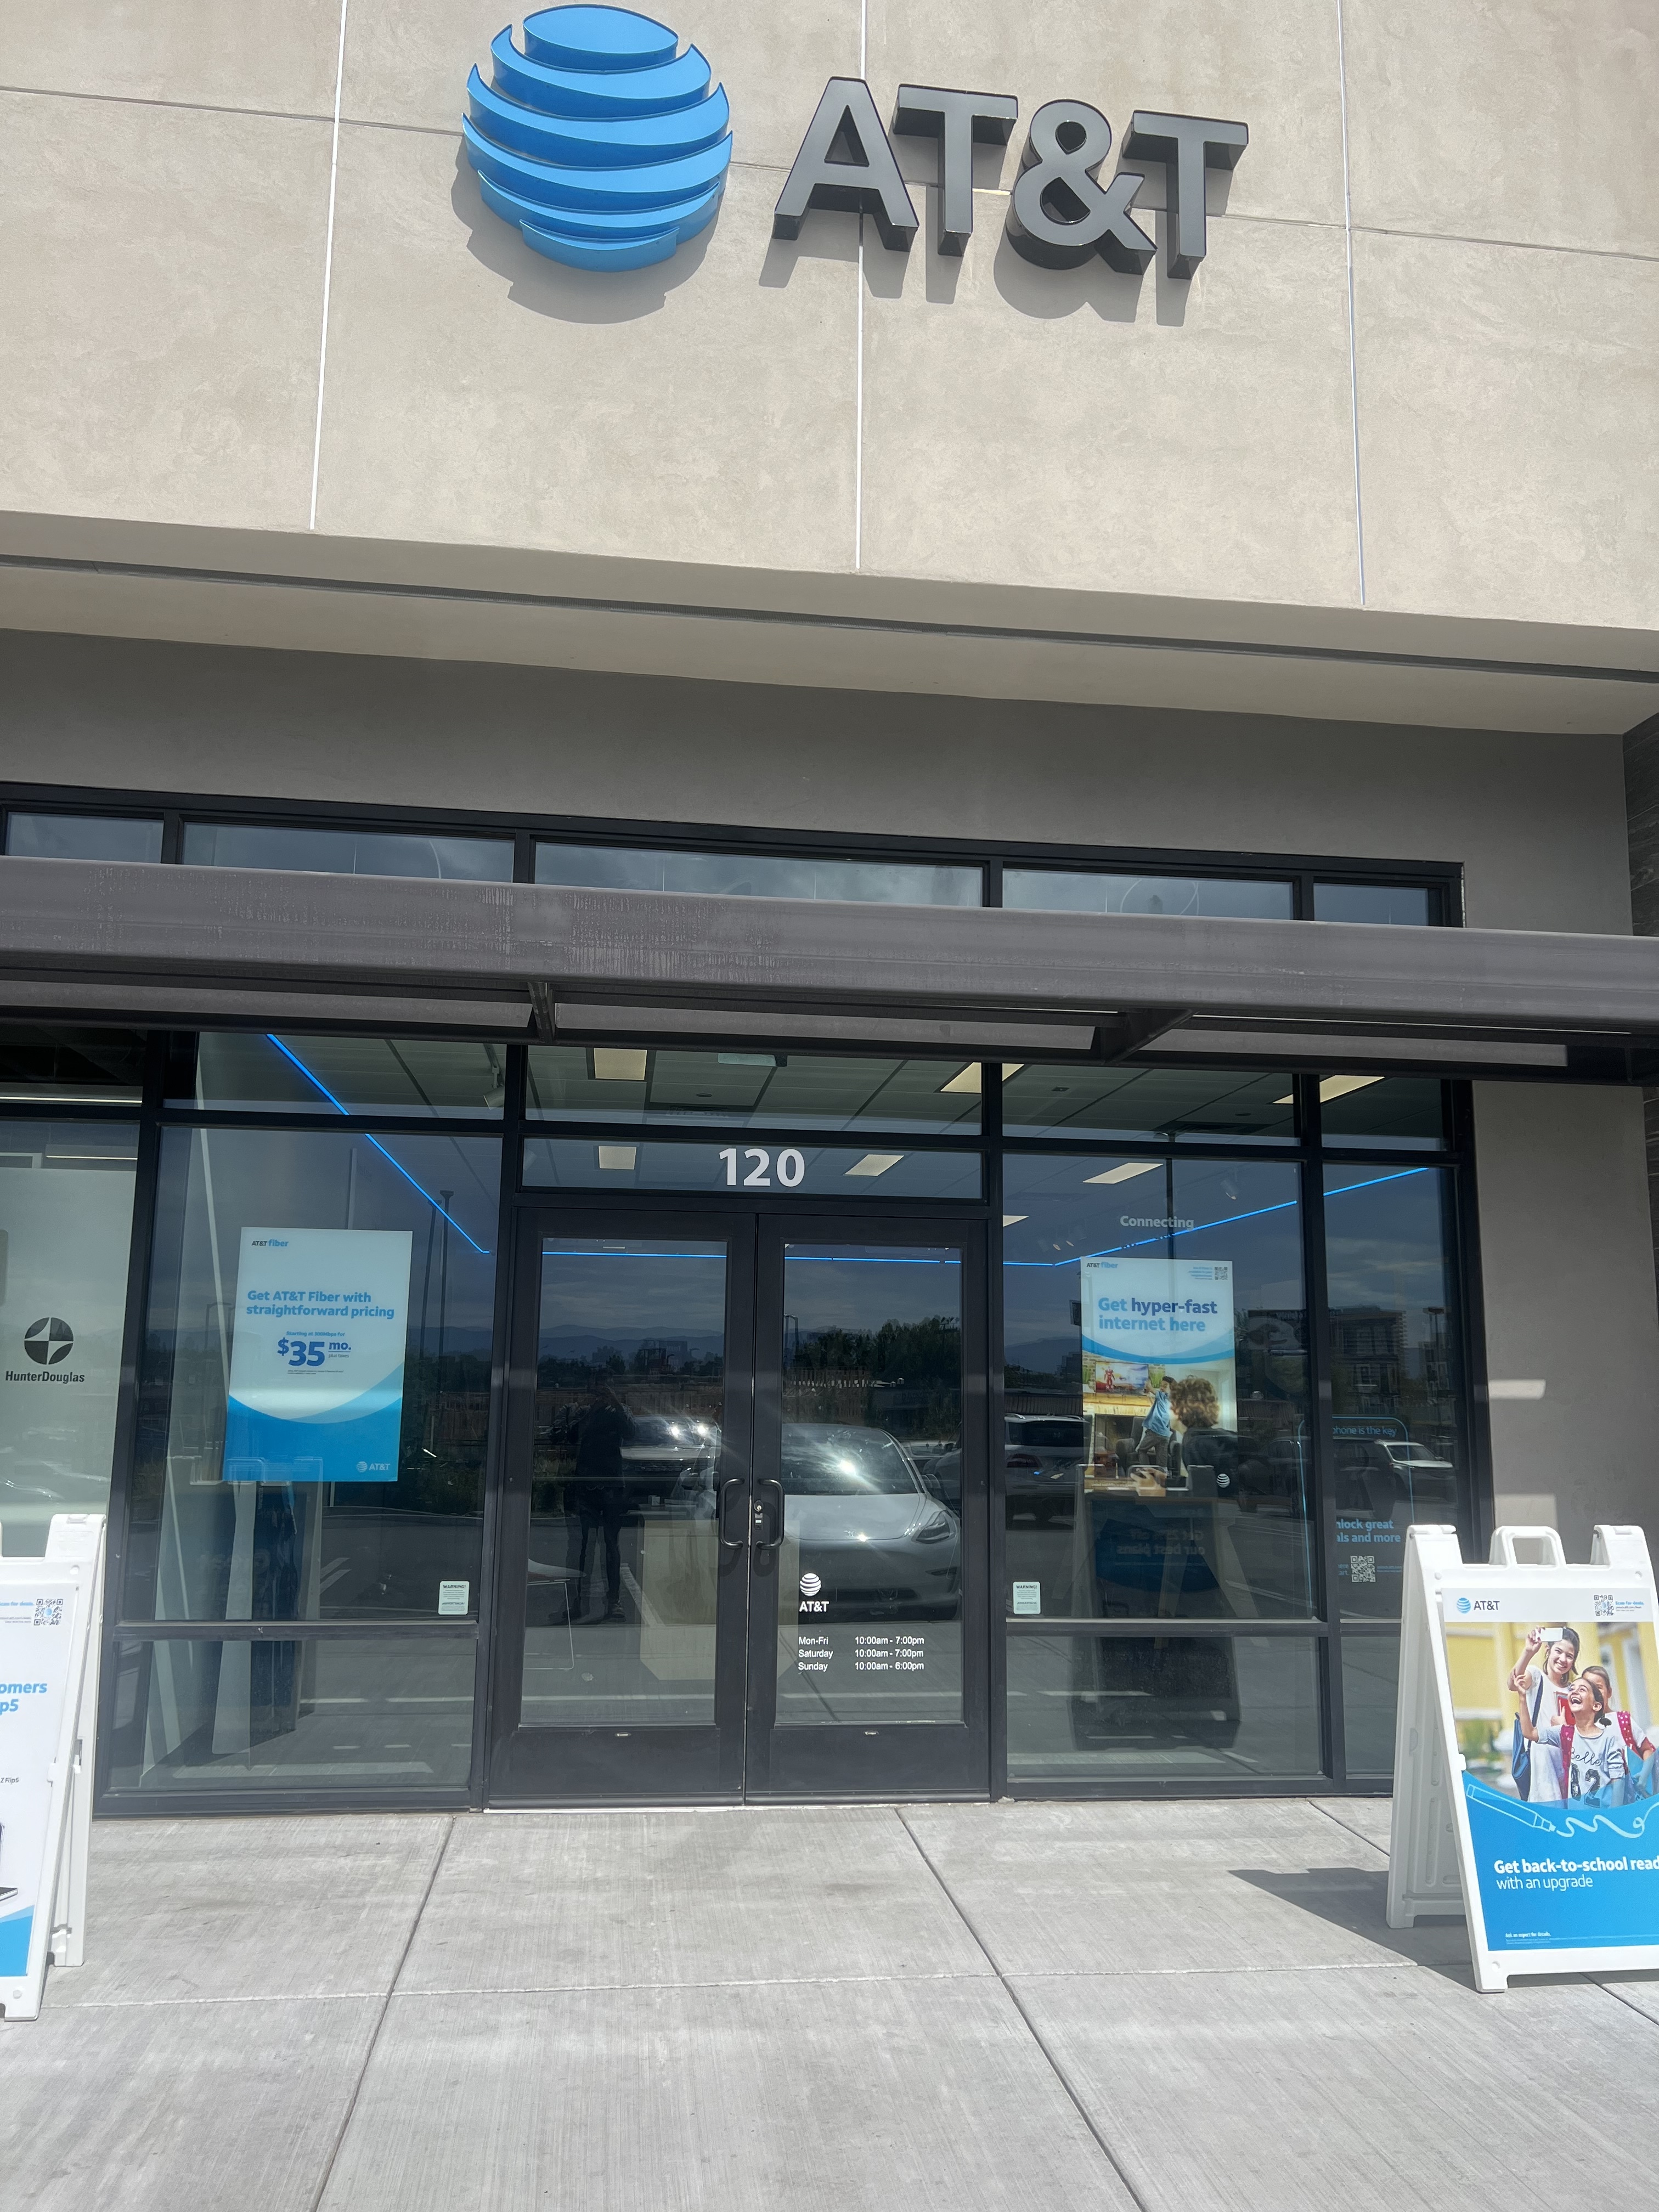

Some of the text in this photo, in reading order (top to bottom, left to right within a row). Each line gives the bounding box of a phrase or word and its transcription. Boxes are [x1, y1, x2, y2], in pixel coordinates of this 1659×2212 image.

[774, 76, 1249, 274] AT&T
[719, 1148, 805, 1187] 120
[1120, 1215, 1194, 1231] Connecting
[247, 1290, 371, 1302] Get AT&T Fiber with
[246, 1305, 394, 1319] straightforward pricing
[1098, 1297, 1217, 1316] Get hyper-fast
[1099, 1316, 1205, 1331] internet here
[277, 1337, 352, 1367] $35 mo.
[5, 1370, 85, 1384] HunterDouglas
[1358, 1425, 1365, 1435] is
[1366, 1425, 1381, 1435] the
[1382, 1425, 1397, 1438] key
[369, 1463, 391, 1471] AT&T
[1365, 1520, 1394, 1532] great
[1352, 1532, 1371, 1543] and
[1373, 1534, 1401, 1543] more
[799, 1601, 830, 1612] AT&T
[1474, 1600, 1500, 1611] AT&T
[798, 1636, 828, 1645] Mon-Fri
[855, 1636, 888, 1645] 10:00am
[895, 1636, 924, 1646] 7:00pm
[798, 1649, 833, 1660] Saturday
[855, 1649, 888, 1658] 10:00am
[895, 1649, 924, 1659] 7:00pm
[798, 1662, 828, 1672] Sunday
[855, 1662, 888, 1671] 10:00am
[895, 1662, 924, 1672] 6:00pm
[1494, 1859, 1520, 1874] Get
[1521, 1857, 1628, 1874] back-to-school
[1496, 1874, 1593, 1892] with an upgrade
